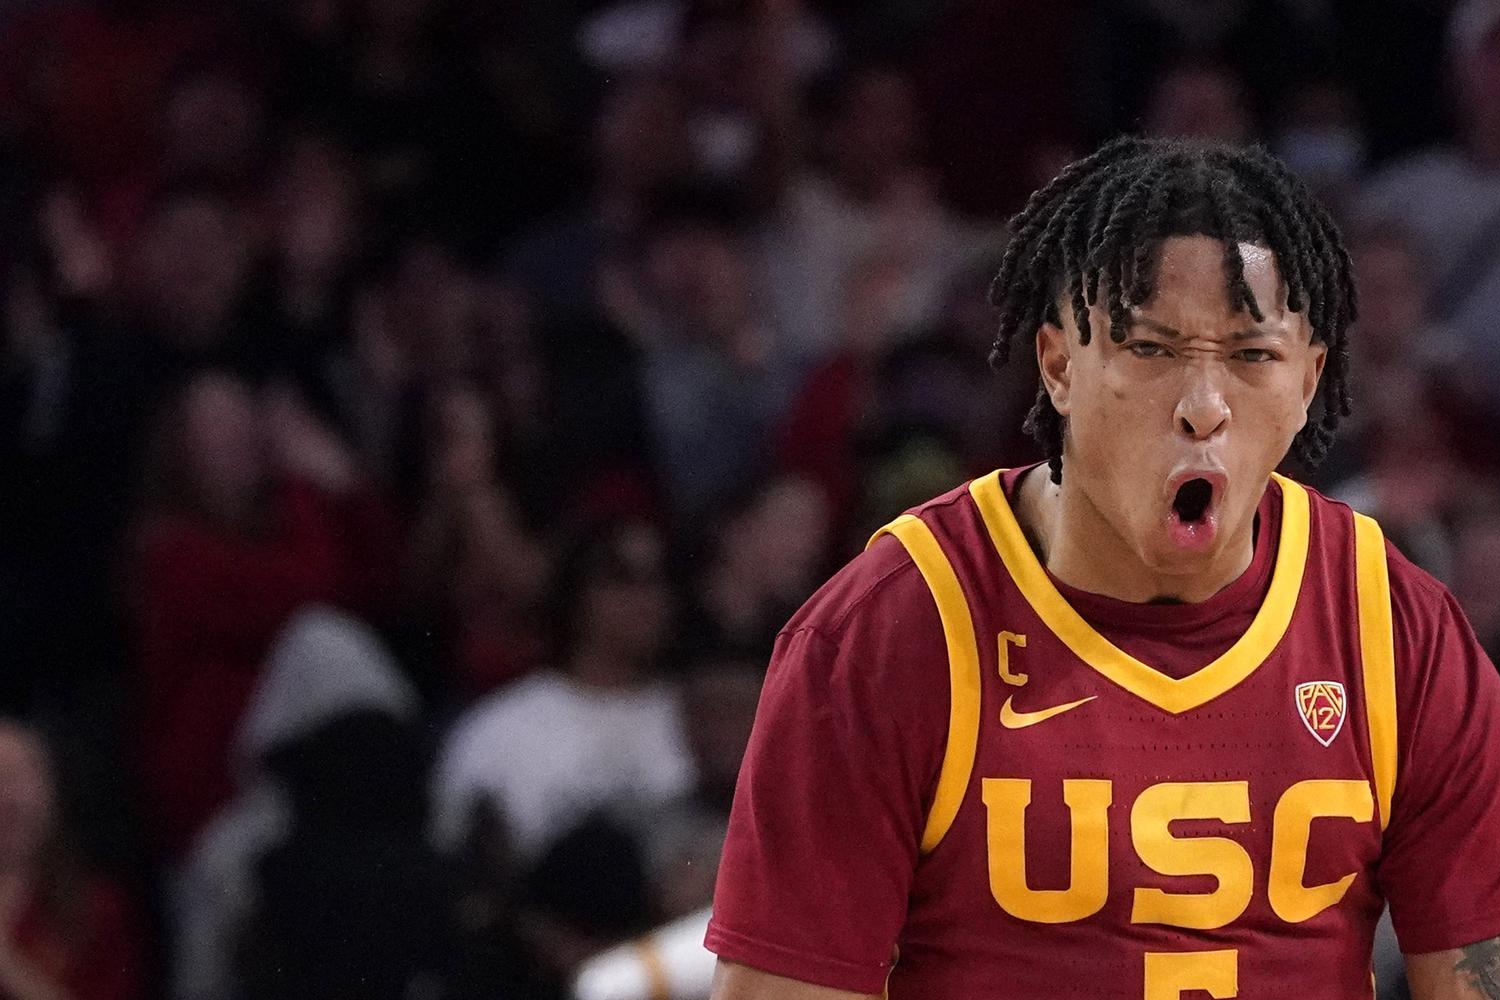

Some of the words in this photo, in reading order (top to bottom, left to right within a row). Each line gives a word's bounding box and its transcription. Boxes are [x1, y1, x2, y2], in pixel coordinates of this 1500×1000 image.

[997, 630, 1028, 686] C
[1299, 684, 1343, 719] PAC
[1312, 707, 1336, 730] 12
[981, 777, 1375, 931] USC
